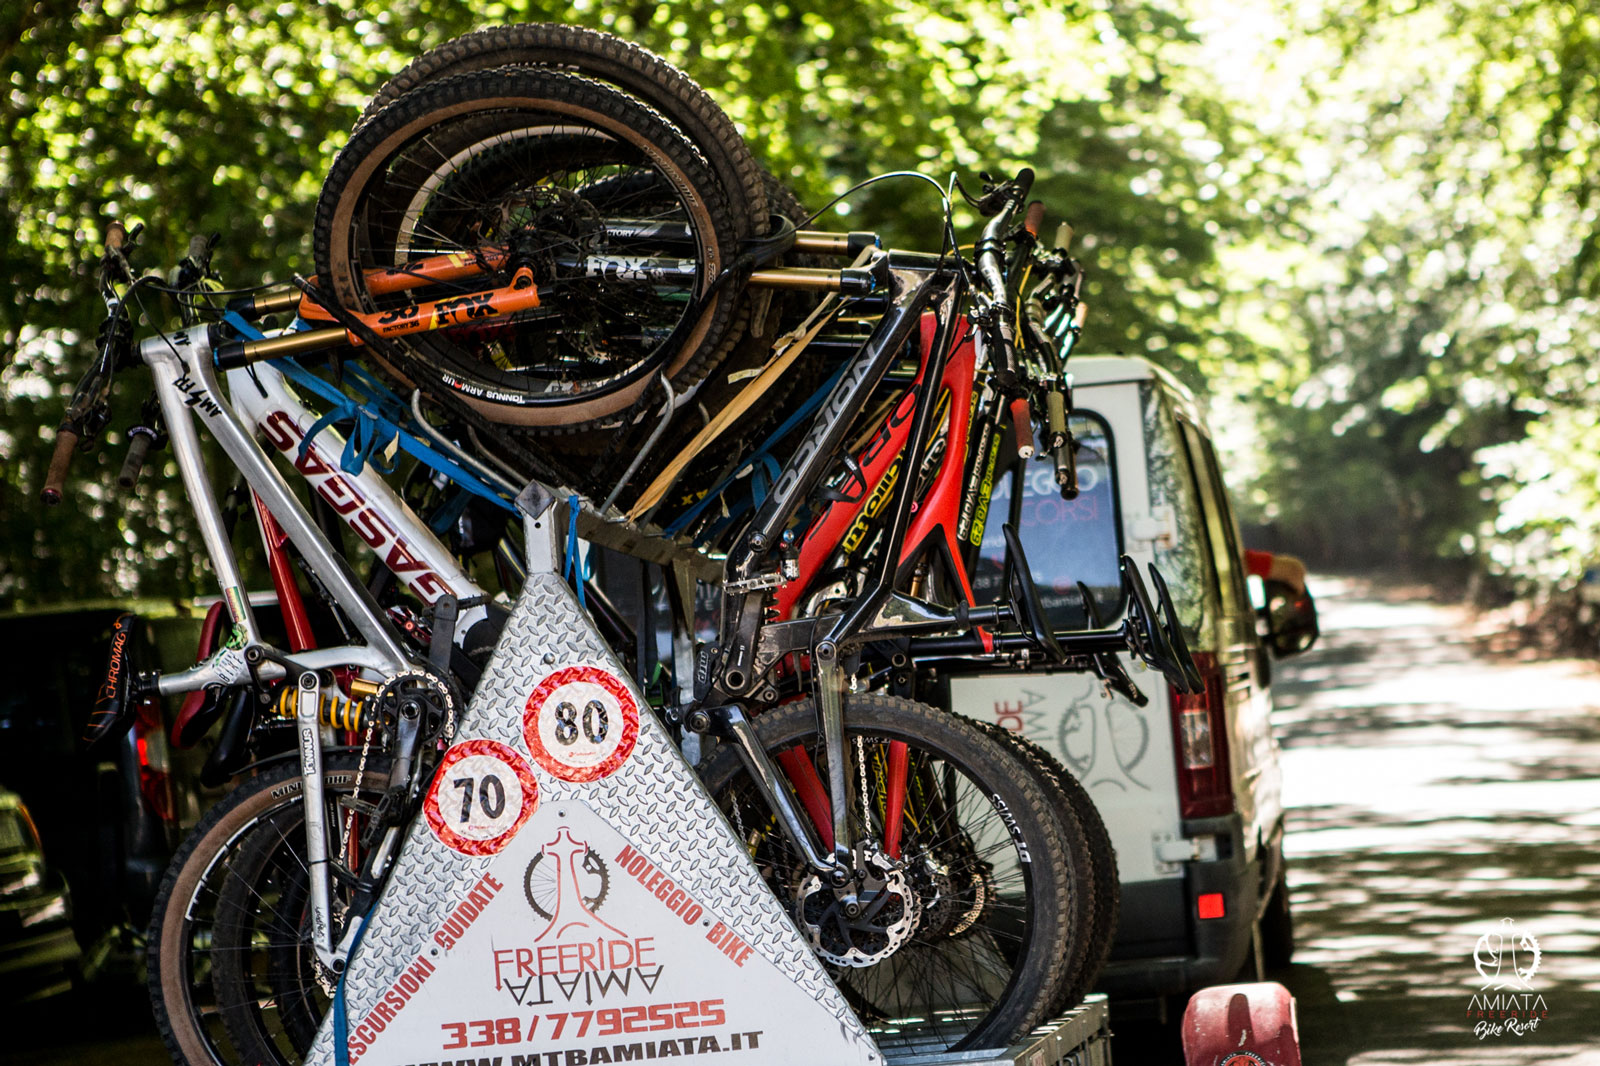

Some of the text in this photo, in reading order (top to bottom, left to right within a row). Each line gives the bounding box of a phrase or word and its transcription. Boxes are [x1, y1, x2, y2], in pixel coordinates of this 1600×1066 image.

[586, 255, 650, 280] FOX
[410, 320, 420, 329] 36
[434, 292, 499, 325] FOX
[774, 345, 881, 504] NORCO
[258, 411, 457, 607] GASGAS
[105, 632, 127, 699] CHROMAG
[555, 700, 609, 746] 80
[453, 775, 505, 823] 70
[989, 793, 1032, 863] DT SWISS
[615, 844, 755, 968] NOLEGGIO BIKE
[348, 872, 504, 1066] ESCURSIONI GUIDATE
[493, 936, 657, 992] FREERIDE
[503, 965, 664, 1006] AMIATA
[441, 999, 725, 1050] 338/7792525
